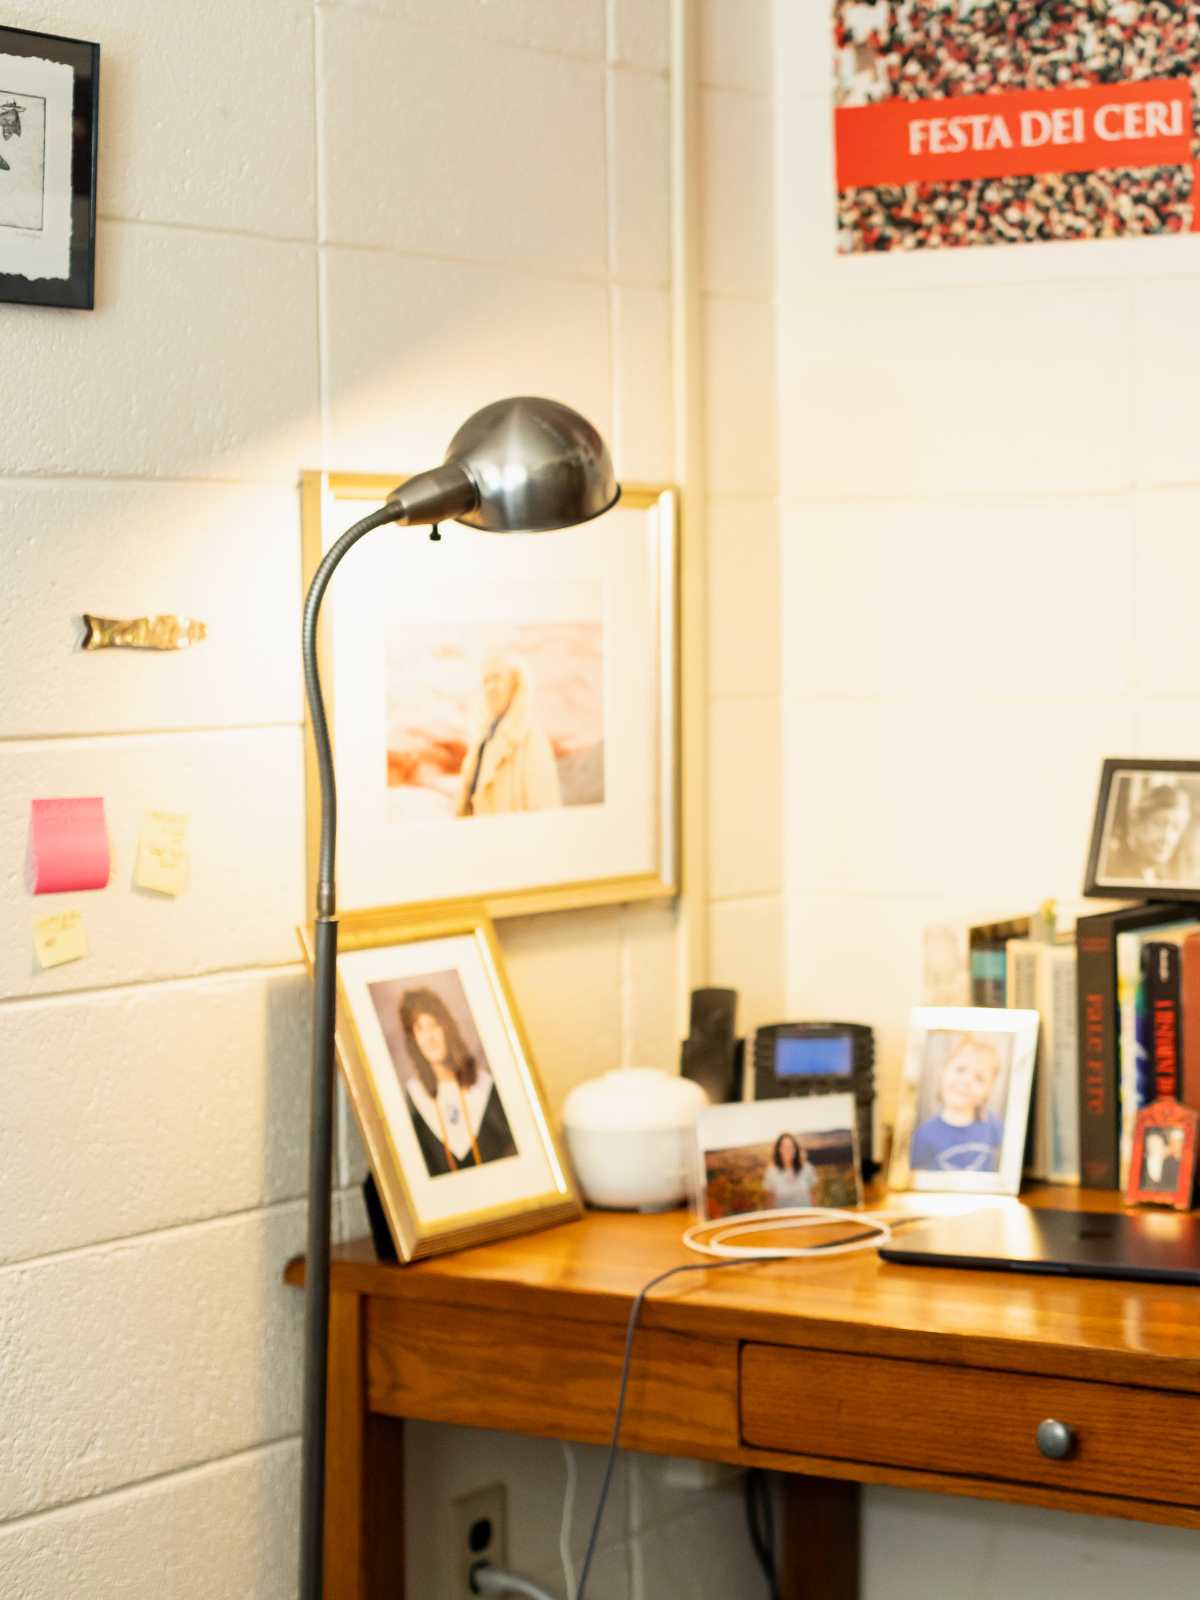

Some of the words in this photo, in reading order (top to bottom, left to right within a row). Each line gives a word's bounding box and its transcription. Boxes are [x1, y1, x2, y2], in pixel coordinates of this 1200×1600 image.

[907, 112, 1012, 155] FESTA
[1020, 105, 1085, 147] DEI
[1093, 99, 1184, 141] CERI
